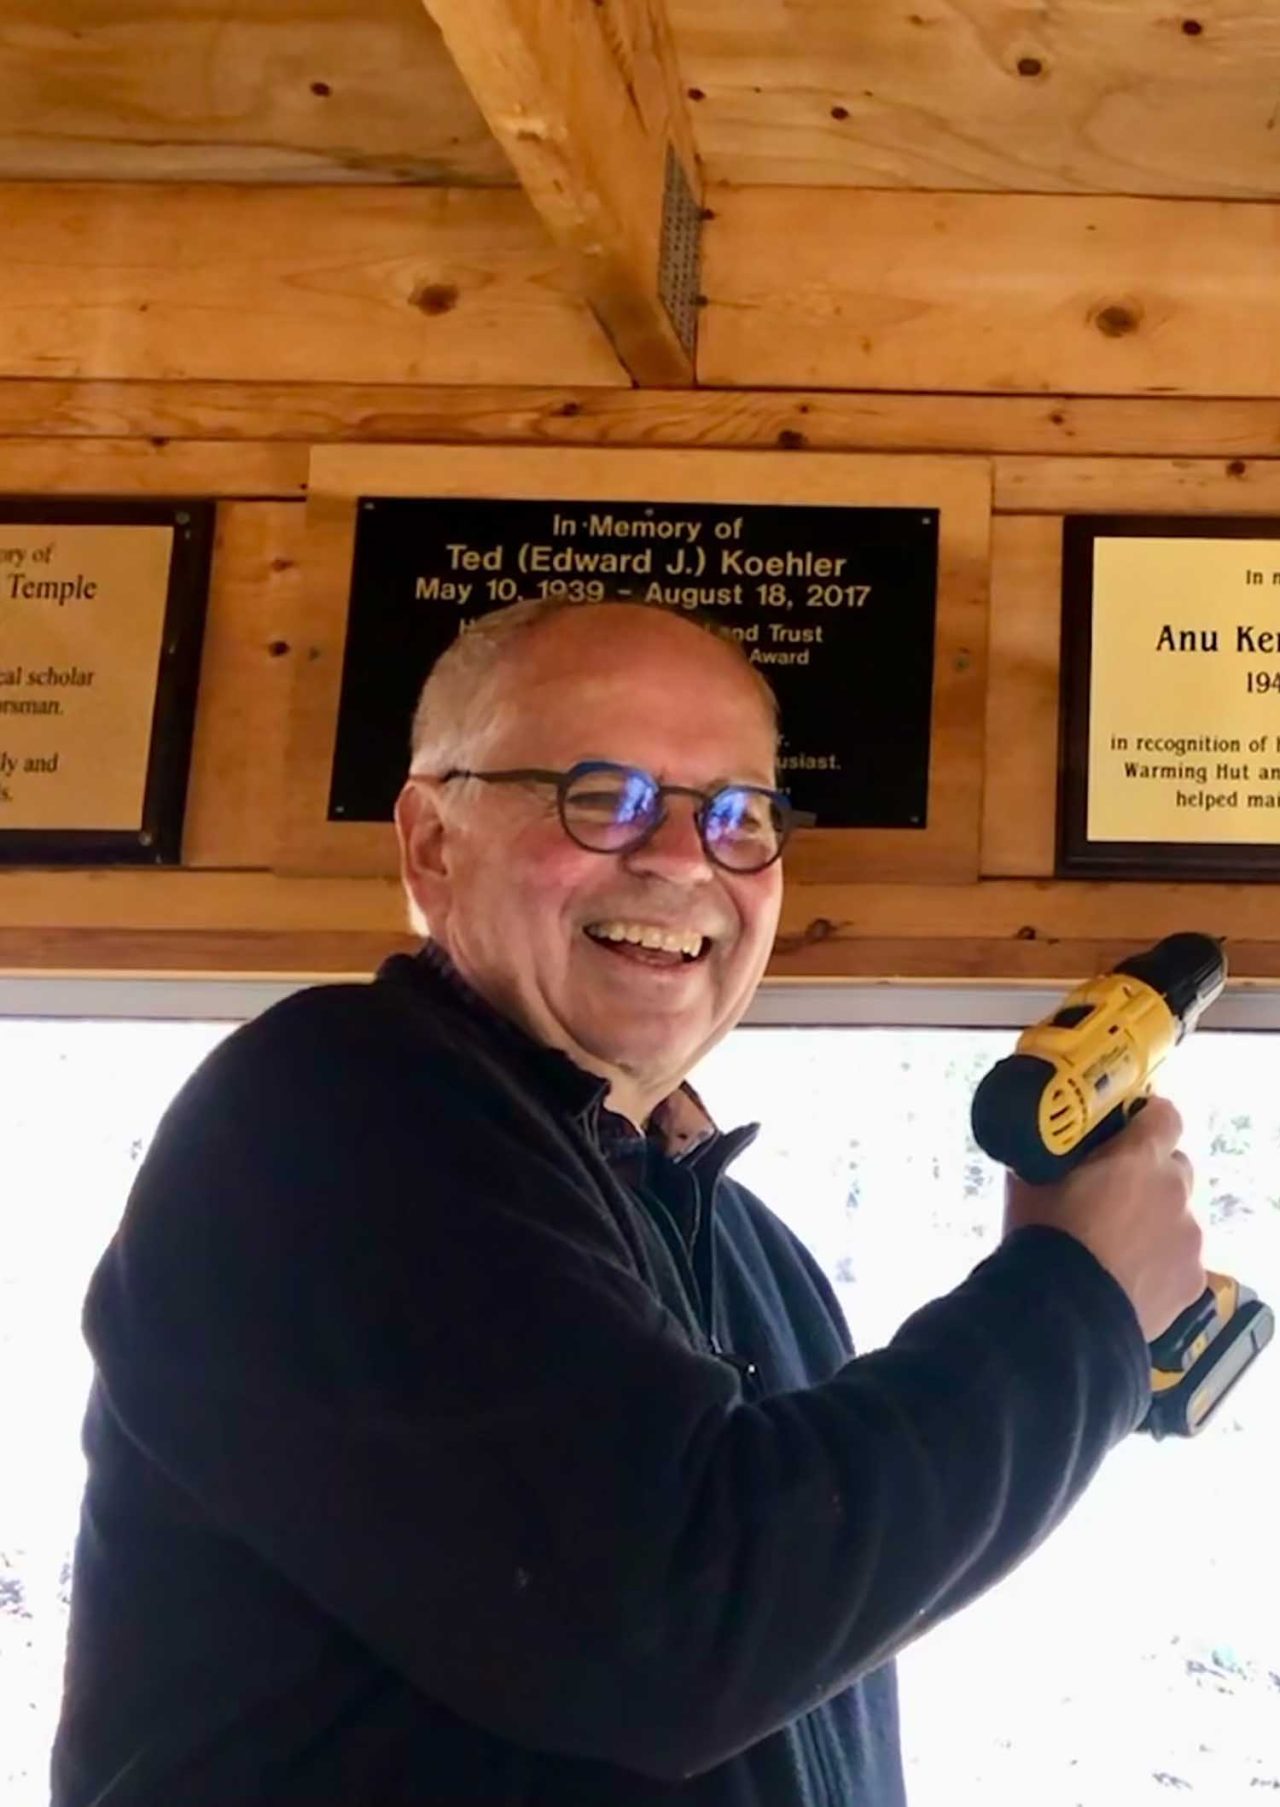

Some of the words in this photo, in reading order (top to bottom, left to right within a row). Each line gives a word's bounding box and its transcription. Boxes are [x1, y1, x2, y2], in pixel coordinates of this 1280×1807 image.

[552, 513, 577, 537] In
[589, 514, 702, 542] Memory
[714, 516, 744, 540] of
[0, 548, 26, 569] ry
[31, 541, 56, 565] of
[446, 543, 503, 571] Ted
[517, 542, 652, 574] (Edward
[665, 547, 707, 577] J.)
[721, 550, 847, 577] Koehler
[1246, 569, 1264, 586] In
[7, 572, 98, 607] Temple
[415, 577, 473, 604] May
[536, 579, 605, 603] 1939
[645, 581, 743, 610] August
[755, 583, 794, 611] 18,
[805, 585, 872, 608] 2017
[768, 623, 824, 644] Trust
[1156, 624, 1219, 653] Anu
[749, 648, 811, 666] Award
[25, 665, 95, 688] scholar
[1110, 736, 1128, 750] in
[1136, 735, 1241, 756] recognition
[1248, 736, 1269, 753] of
[23, 751, 60, 774] and
[1124, 762, 1207, 783] Warming
[1216, 763, 1249, 780] Hut
[1176, 790, 1238, 812] helped
